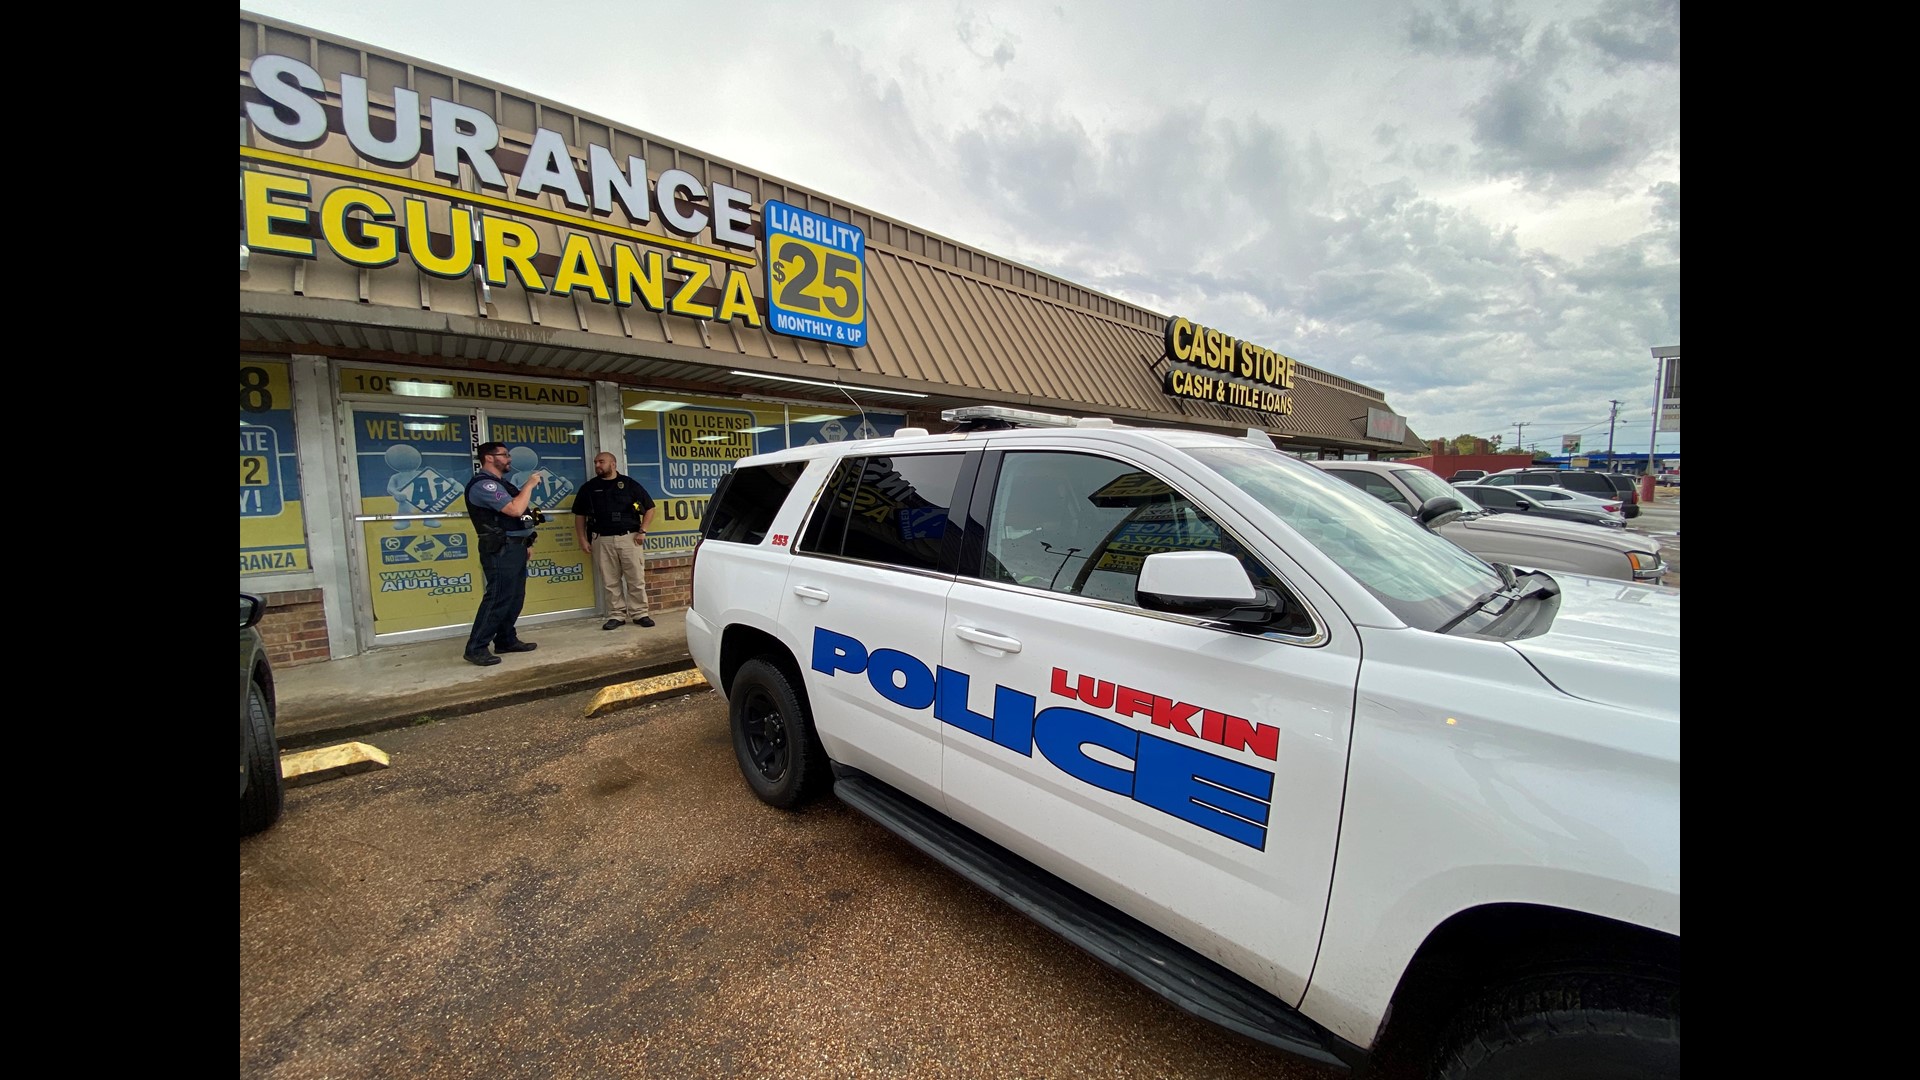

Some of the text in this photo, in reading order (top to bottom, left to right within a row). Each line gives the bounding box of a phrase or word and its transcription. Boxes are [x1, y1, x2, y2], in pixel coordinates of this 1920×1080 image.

[246, 53, 756, 250] SURANCE
[771, 205, 860, 252] LIABILITY
[242, 168, 761, 328] EGURANZA
[777, 314, 861, 342] MONTHLY & UP
[1173, 317, 1296, 389] CASH STORE
[432, 379, 579, 403] MBERLAND
[1173, 369, 1293, 415] CASH & TITLE LOANS
[366, 420, 462, 441] WELCOME
[669, 413, 750, 429] NO LICENSE
[493, 424, 578, 444] BIENVENIDO
[670, 428, 750, 446] NO CREDIT
[671, 446, 751, 458] NO BANK ACCT
[669, 463, 688, 477] NO
[670, 478, 684, 489] NO
[688, 478, 708, 489] ONE
[643, 535, 702, 550] NSURANCE
[772, 534, 789, 547] 253
[527, 563, 583, 577] United
[382, 573, 471, 592] AiUnited
[1051, 667, 1280, 762] LUFKIN
[811, 626, 1276, 852] POLICE
